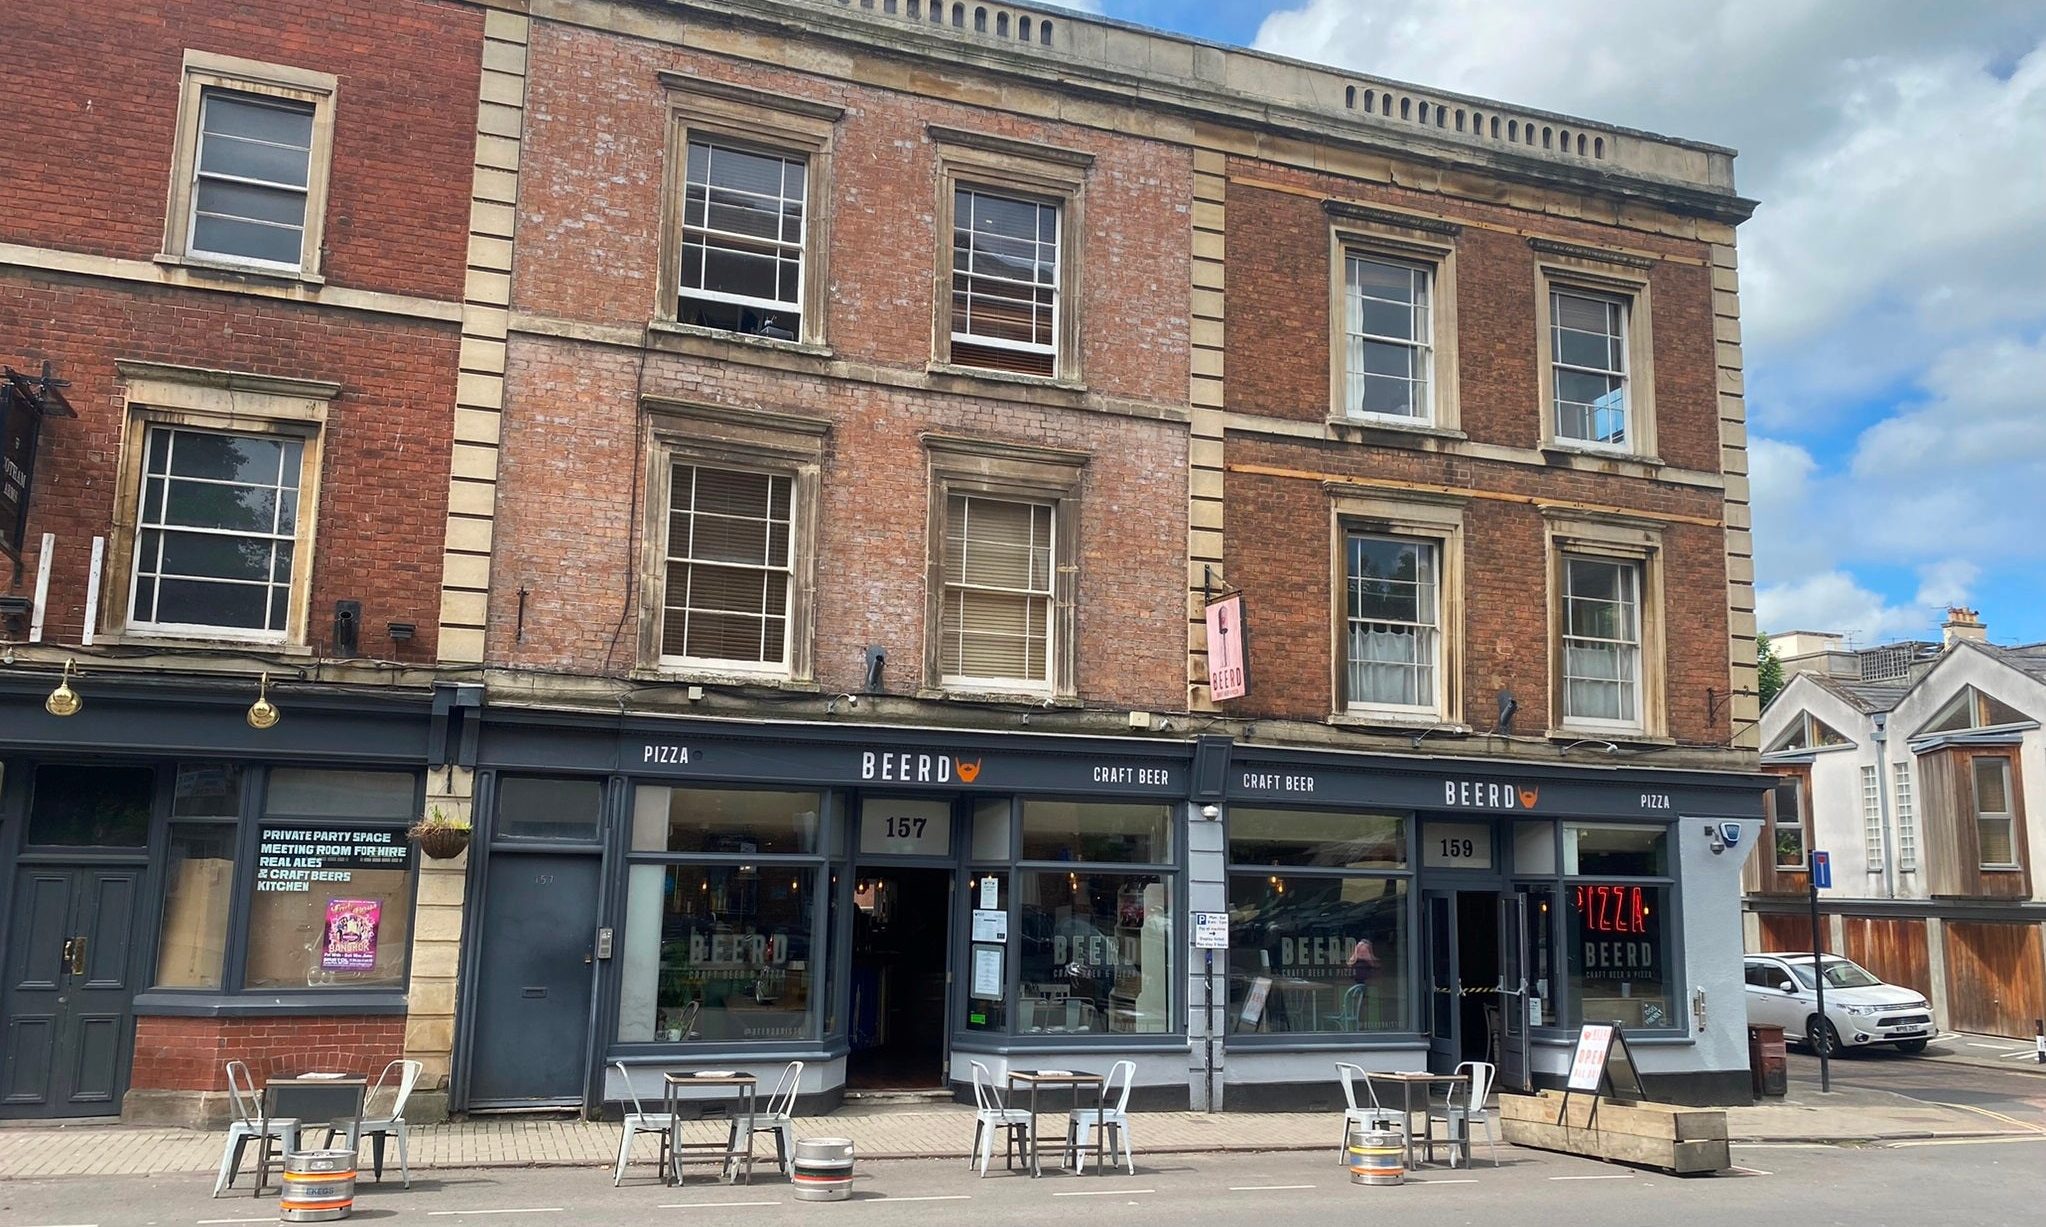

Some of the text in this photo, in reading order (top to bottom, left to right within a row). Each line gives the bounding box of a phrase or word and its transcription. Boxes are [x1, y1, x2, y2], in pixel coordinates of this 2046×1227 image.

[1213, 667, 1242, 691] BEERD
[644, 745, 688, 764] PIZZA
[862, 751, 950, 783] BEERD
[1093, 766, 1169, 785] CRAFT BEER
[1243, 773, 1314, 792] CRAFT BEER
[1445, 780, 1515, 808] BEERD
[1641, 794, 1670, 809] PIZZA
[263, 829, 391, 843] PRIVATE PARTY SPACE
[886, 816, 928, 838] 157
[260, 843, 406, 857] MEETING ROOM FOR HIRE
[1440, 838, 1473, 858] 159
[259, 856, 322, 868] REAL ALES
[257, 869, 351, 882] & CRAFT BEERS
[257, 881, 309, 892] KITCHEN
[1577, 886, 1646, 932] PIZZA
[1198, 915, 1206, 925] P
[690, 933, 788, 965] BEERD
[1054, 935, 1138, 966] BEERD
[1281, 937, 1358, 966] BEERD
[1585, 942, 1652, 967] BEERD
[688, 969, 719, 980] CRAFT
[1586, 971, 1606, 979] CRAFT
